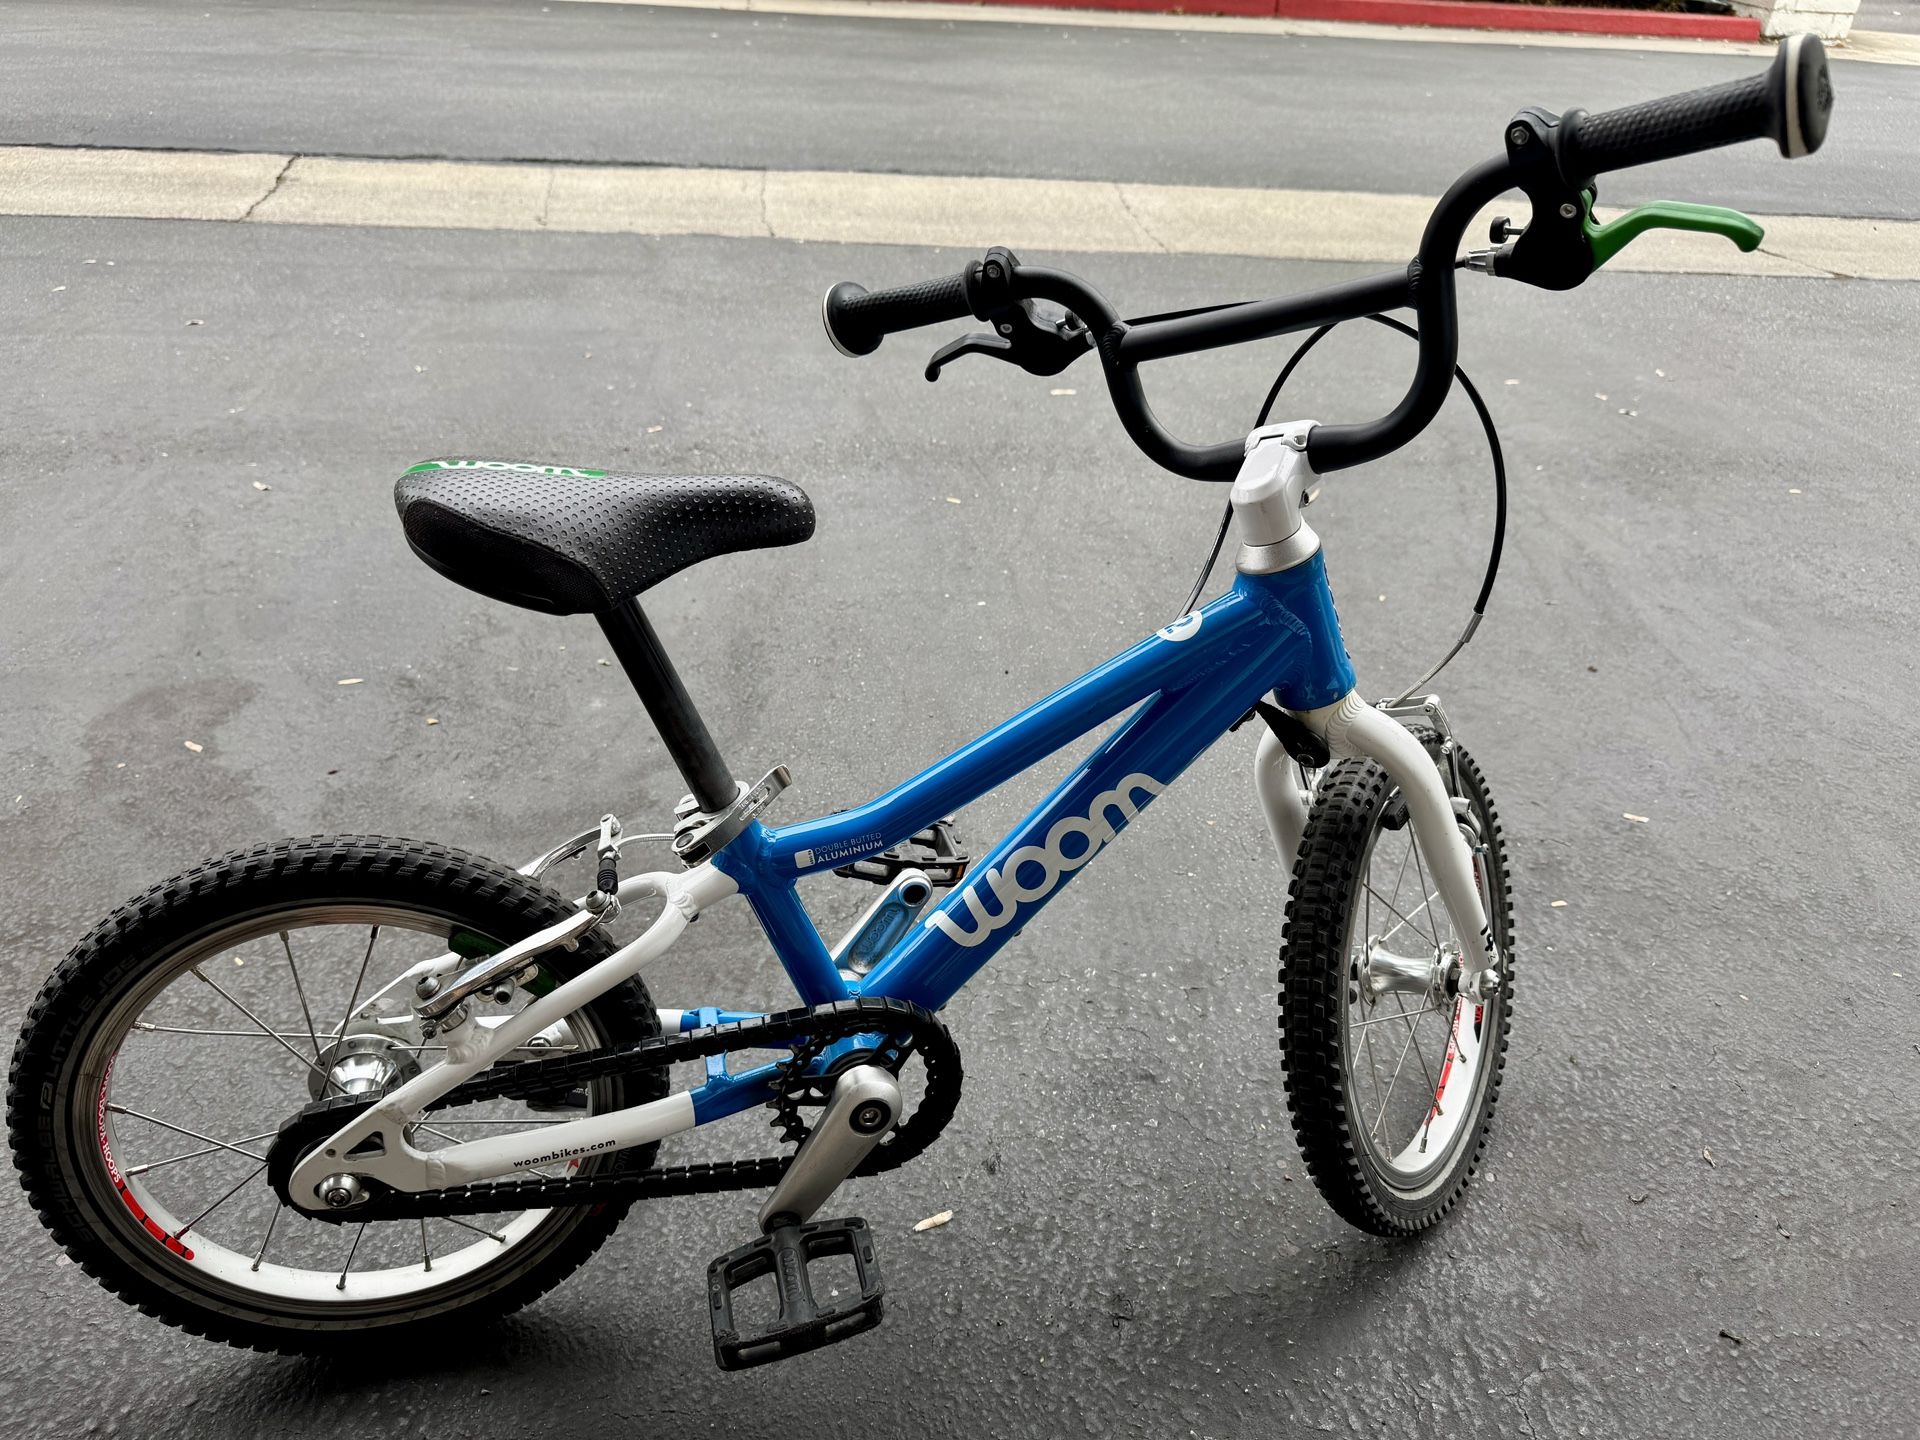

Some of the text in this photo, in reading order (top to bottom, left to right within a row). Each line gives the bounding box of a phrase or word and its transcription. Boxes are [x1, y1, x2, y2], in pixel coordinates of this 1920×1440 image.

[814, 832, 882, 855] DOUBLE BUTTED
[817, 840, 884, 864] ALUMINIUM
[924, 772, 1167, 948] woom
[49, 997, 97, 1080] LITTLE
[513, 1138, 617, 1168] woombikes.com
